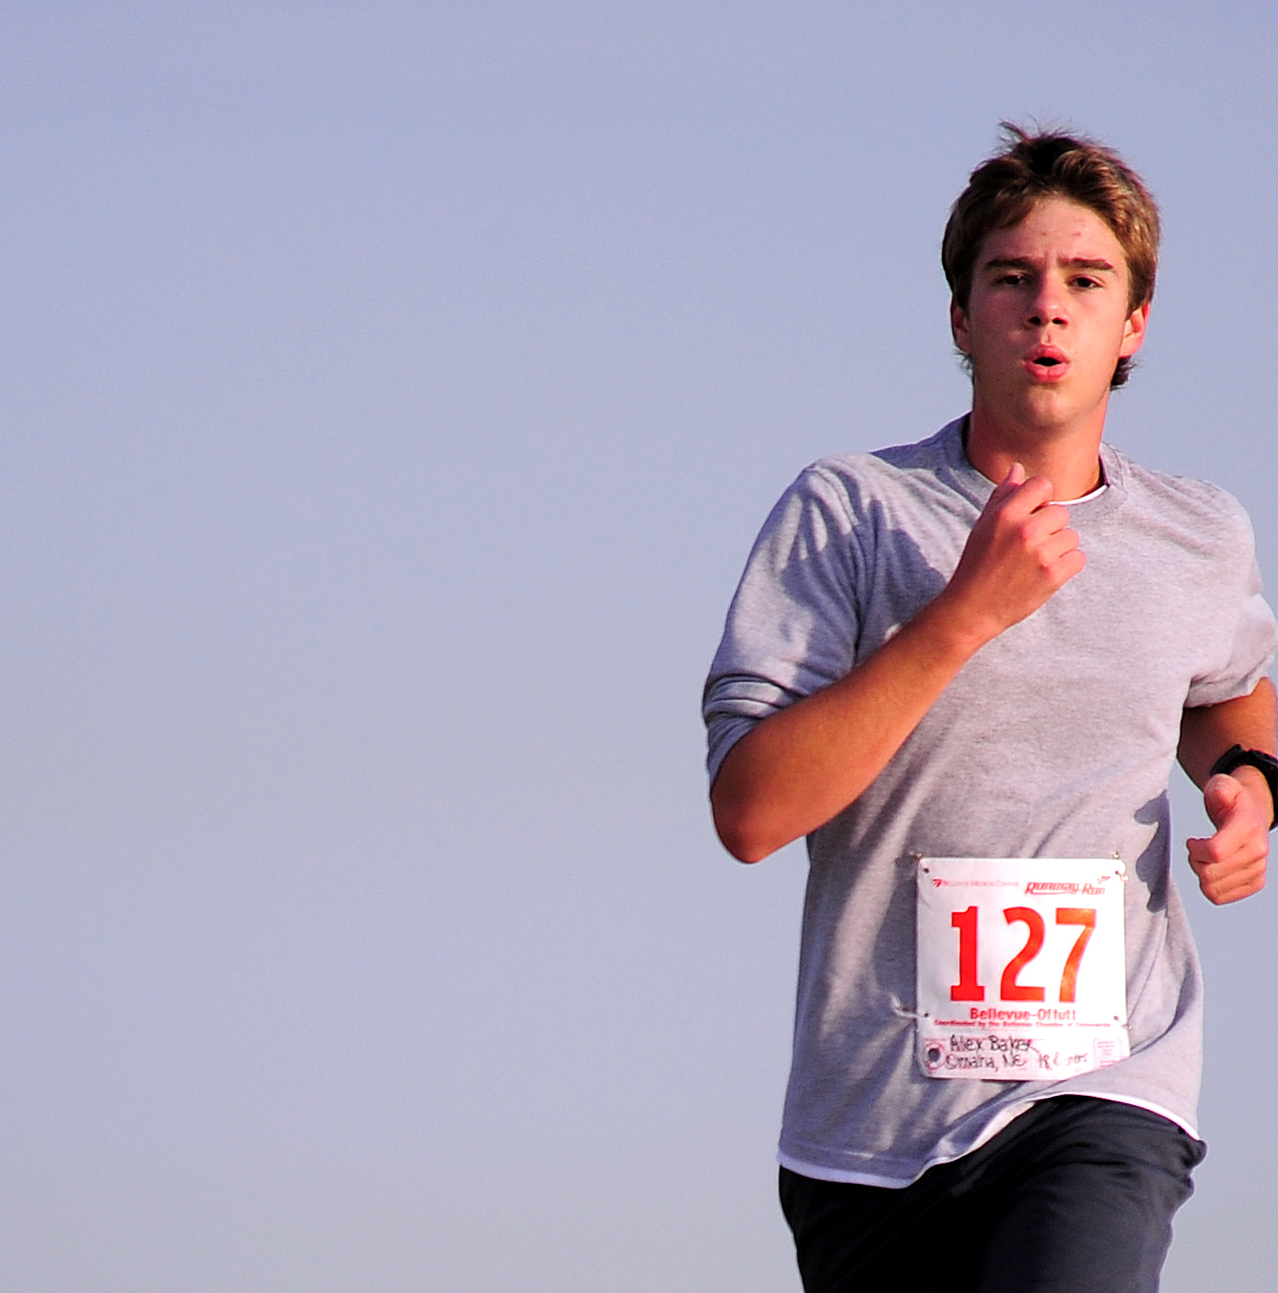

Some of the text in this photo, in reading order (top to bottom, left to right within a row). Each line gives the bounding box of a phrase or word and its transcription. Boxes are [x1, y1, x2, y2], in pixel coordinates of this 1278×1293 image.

[951, 906, 1097, 1003] 127
[970, 1007, 1077, 1021] Bellevue-Offutt
[950, 1033, 985, 1053] Alex
